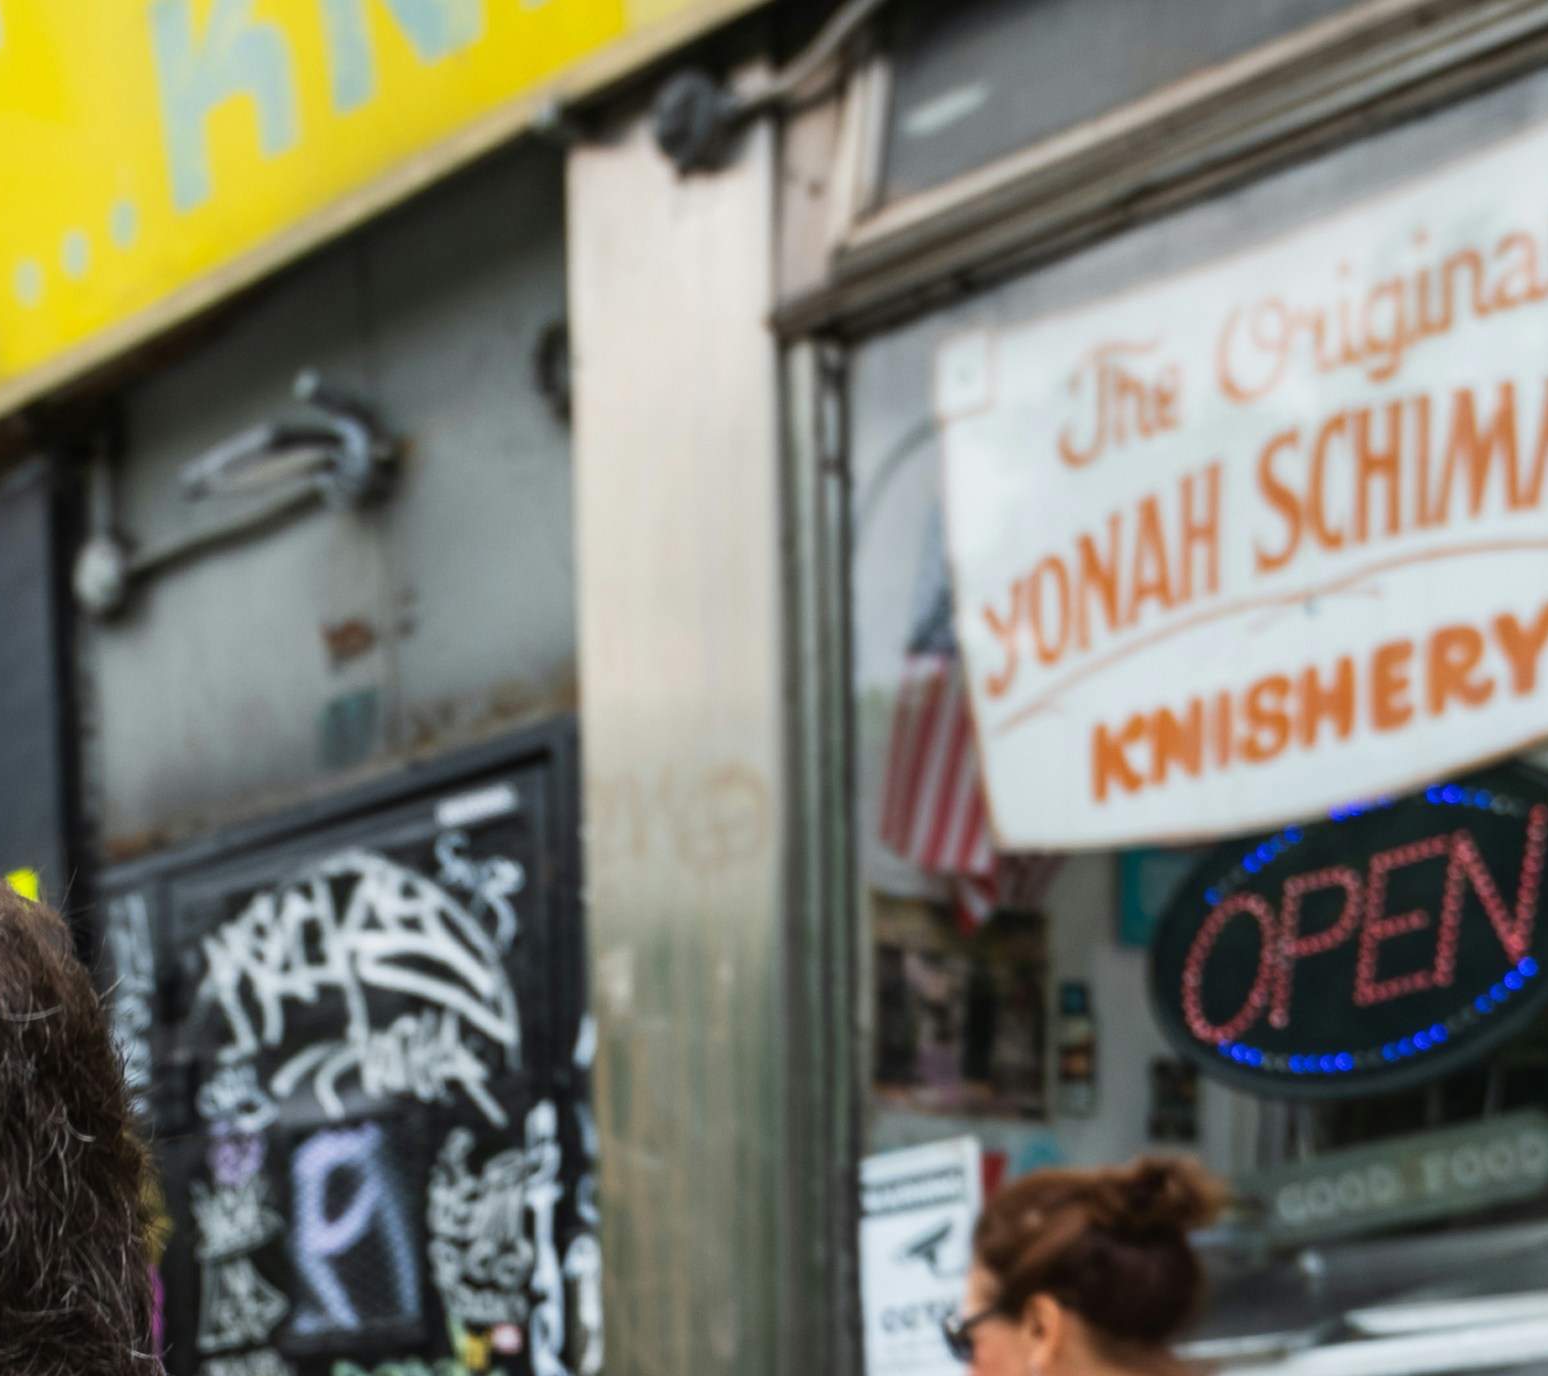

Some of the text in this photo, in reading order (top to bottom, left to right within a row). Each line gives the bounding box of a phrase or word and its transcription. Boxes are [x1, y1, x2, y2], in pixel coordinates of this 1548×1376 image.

[1056, 335, 1183, 468] The
[983, 461, 1222, 700] YONAH
[1275, 1161, 1400, 1226] GOOD
